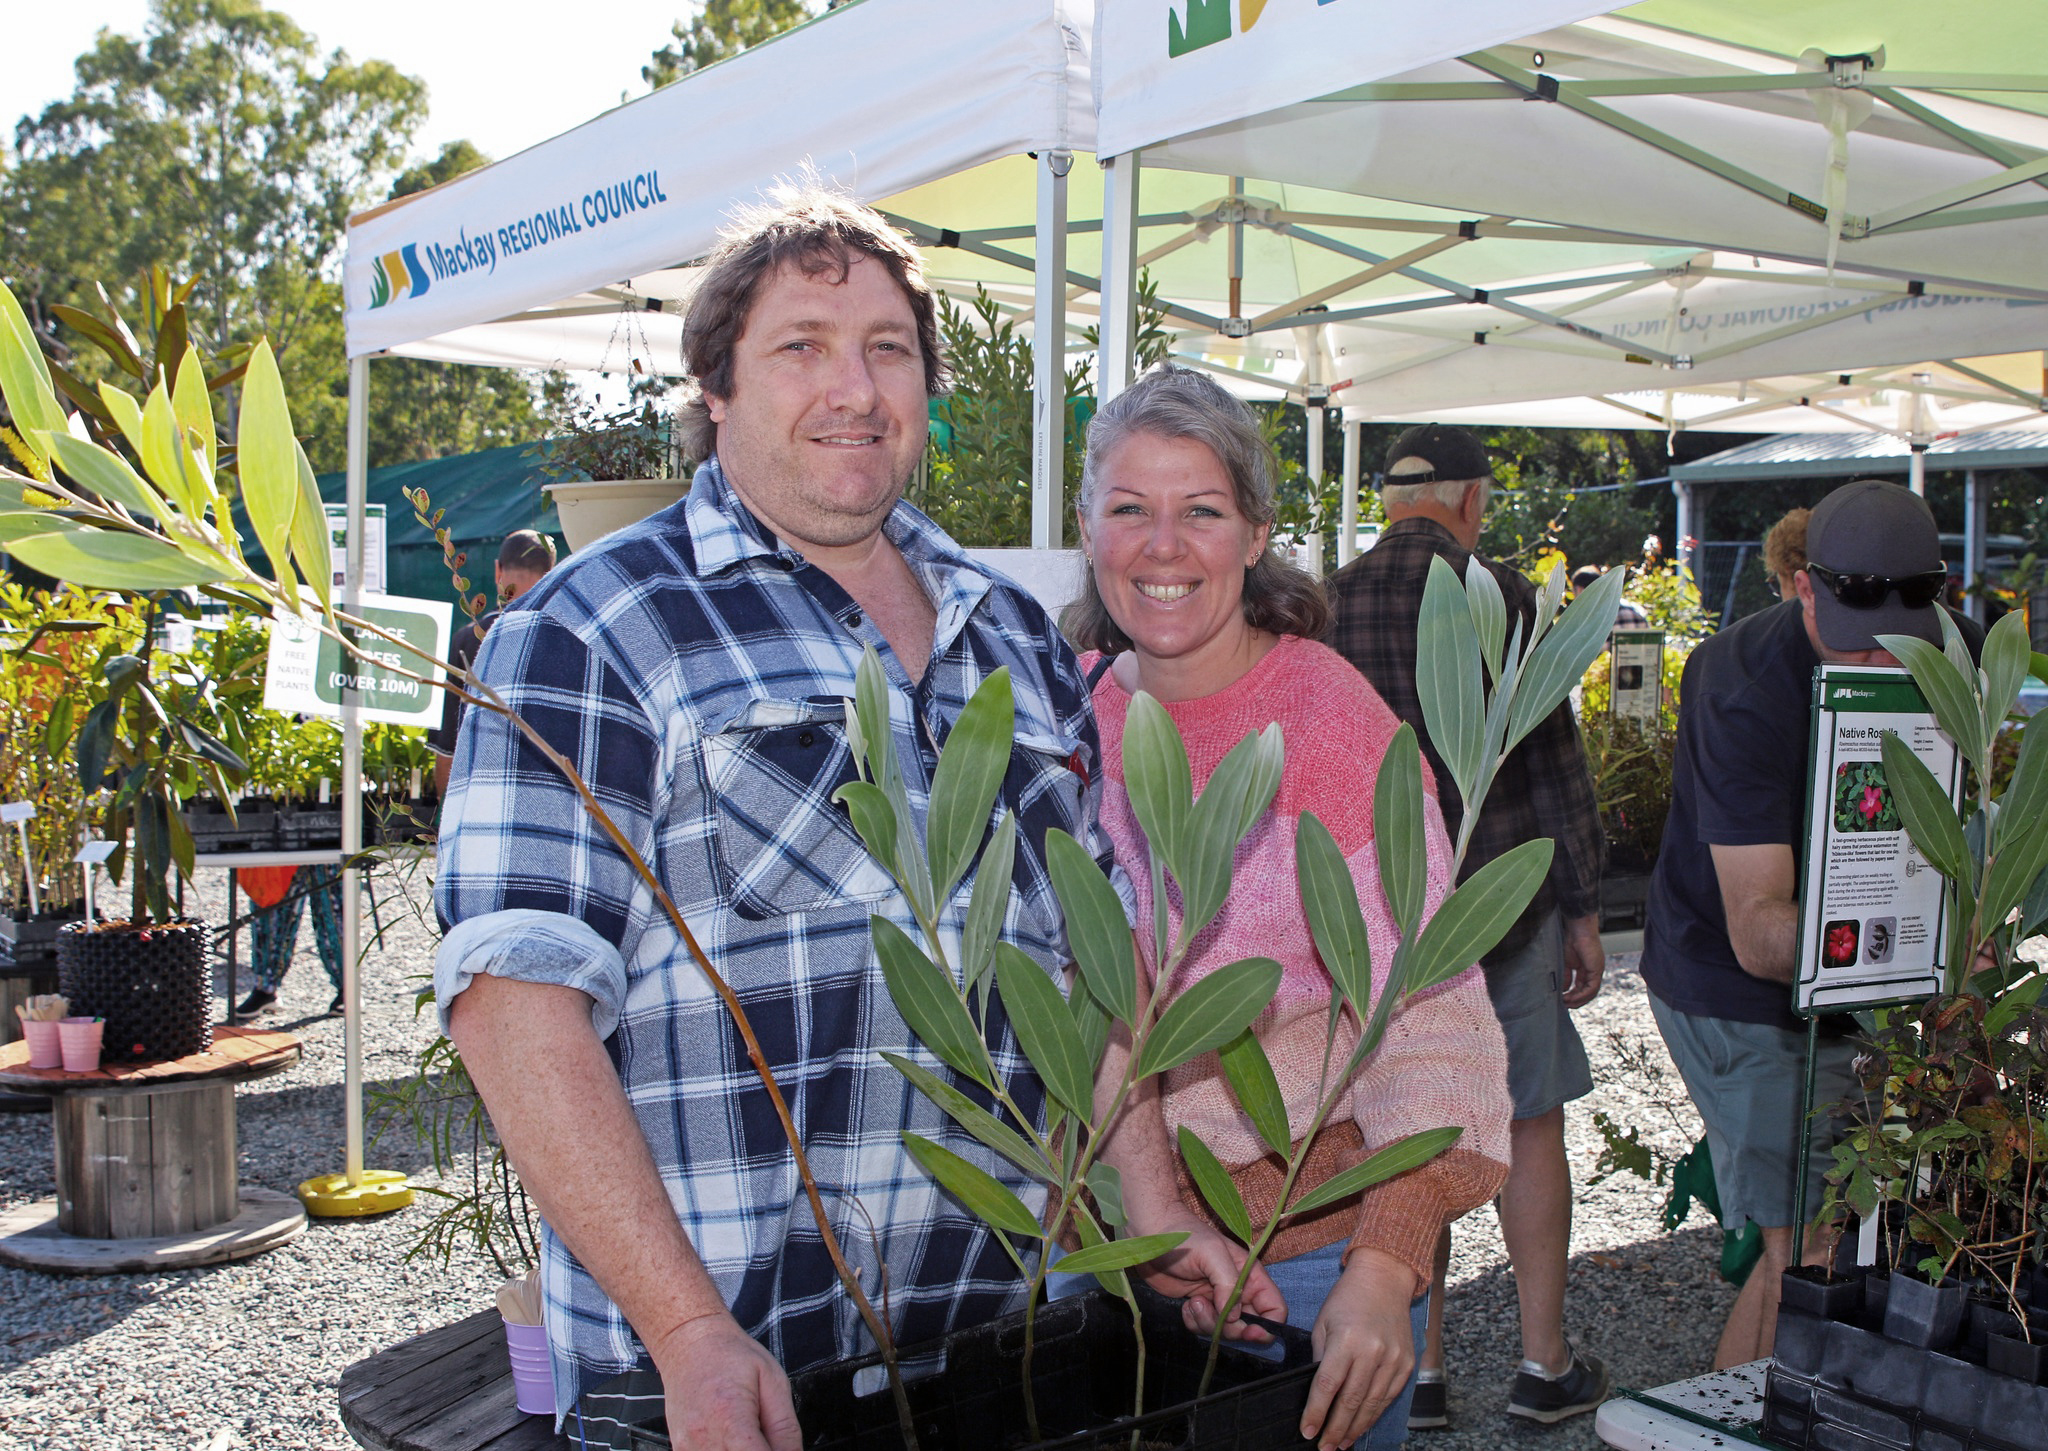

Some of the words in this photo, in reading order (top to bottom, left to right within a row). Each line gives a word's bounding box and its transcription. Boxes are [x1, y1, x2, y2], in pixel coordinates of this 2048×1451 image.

[426, 224, 496, 281] Mackay
[498, 202, 582, 258] REGIONAL
[582, 170, 667, 228] COUNCIL
[284, 650, 306, 661] FREE
[348, 650, 402, 667] EES
[278, 664, 311, 676] NATIVE
[276, 680, 310, 692] PLANTS
[328, 672, 376, 690] (OVER
[380, 678, 419, 698] 10M)
[1852, 690, 1868, 698] Mackay
[1839, 728, 1866, 738] Native
[1868, 728, 1898, 738] Roslla
